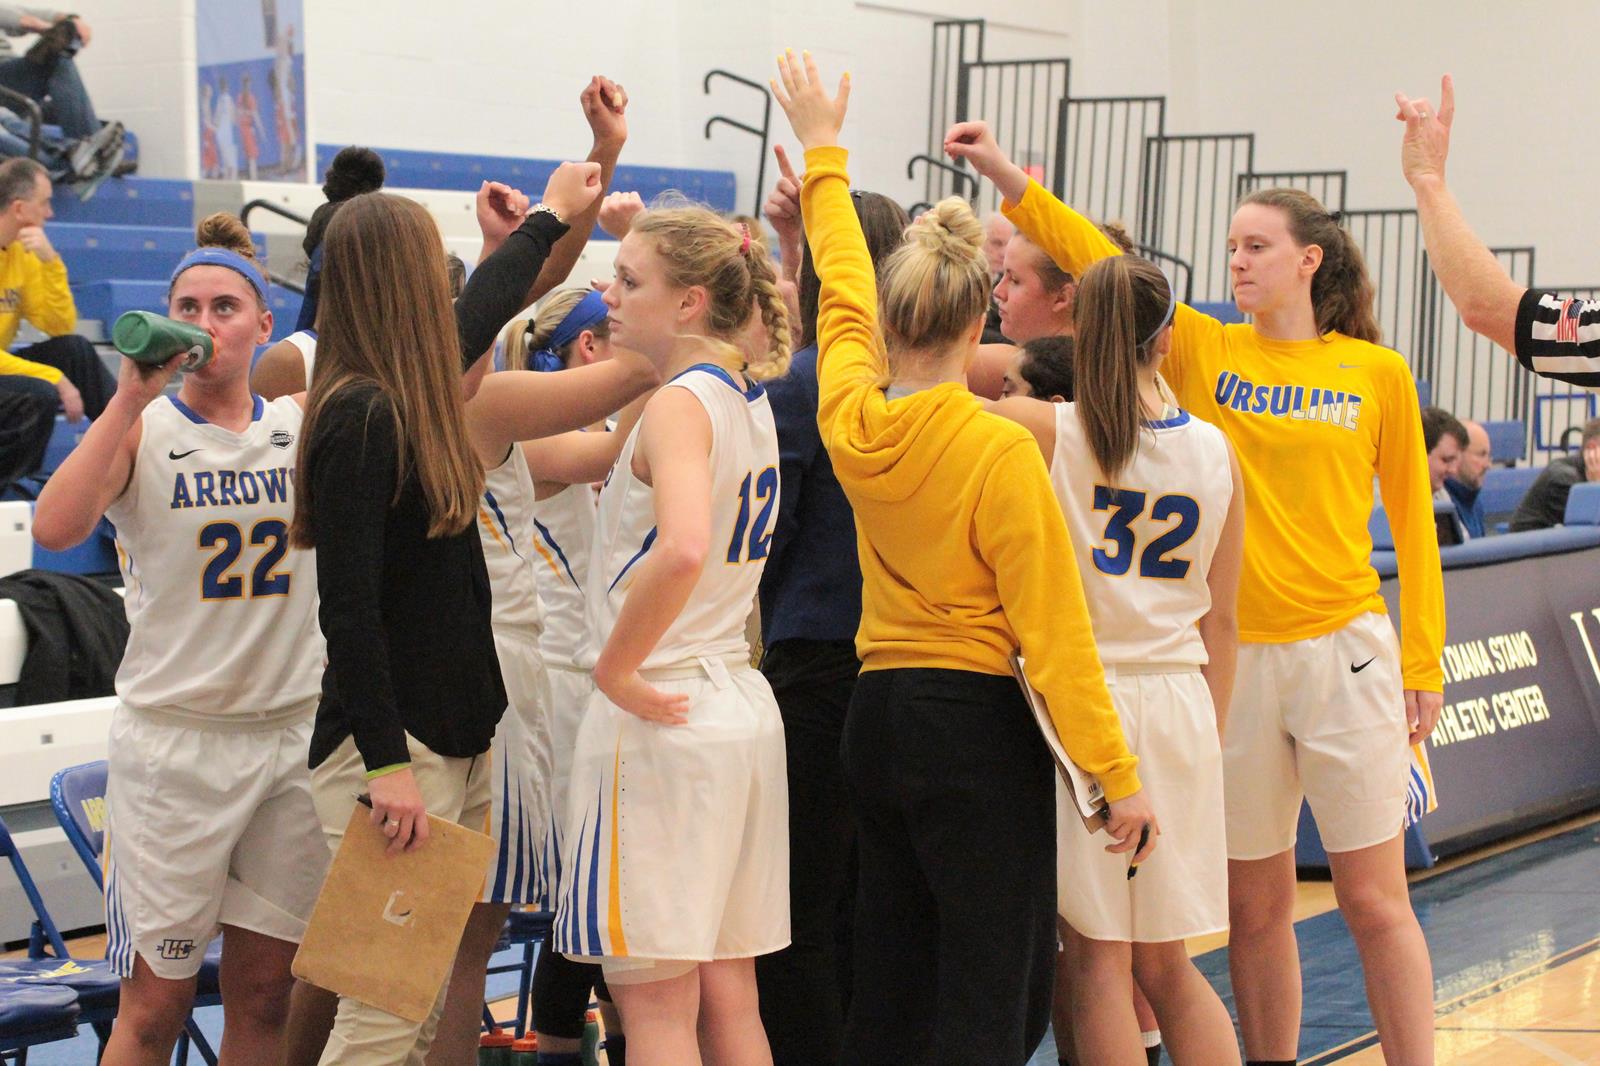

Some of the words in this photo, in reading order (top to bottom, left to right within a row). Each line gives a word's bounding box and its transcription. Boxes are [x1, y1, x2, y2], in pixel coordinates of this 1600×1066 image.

[1214, 370, 1362, 432] URSULINE
[724, 464, 778, 566] 12
[1090, 483, 1201, 580] 32
[197, 517, 293, 602] 22
[1443, 639, 1496, 683] DIANA
[1488, 630, 1538, 674] STANO
[1491, 684, 1550, 731] CENTER
